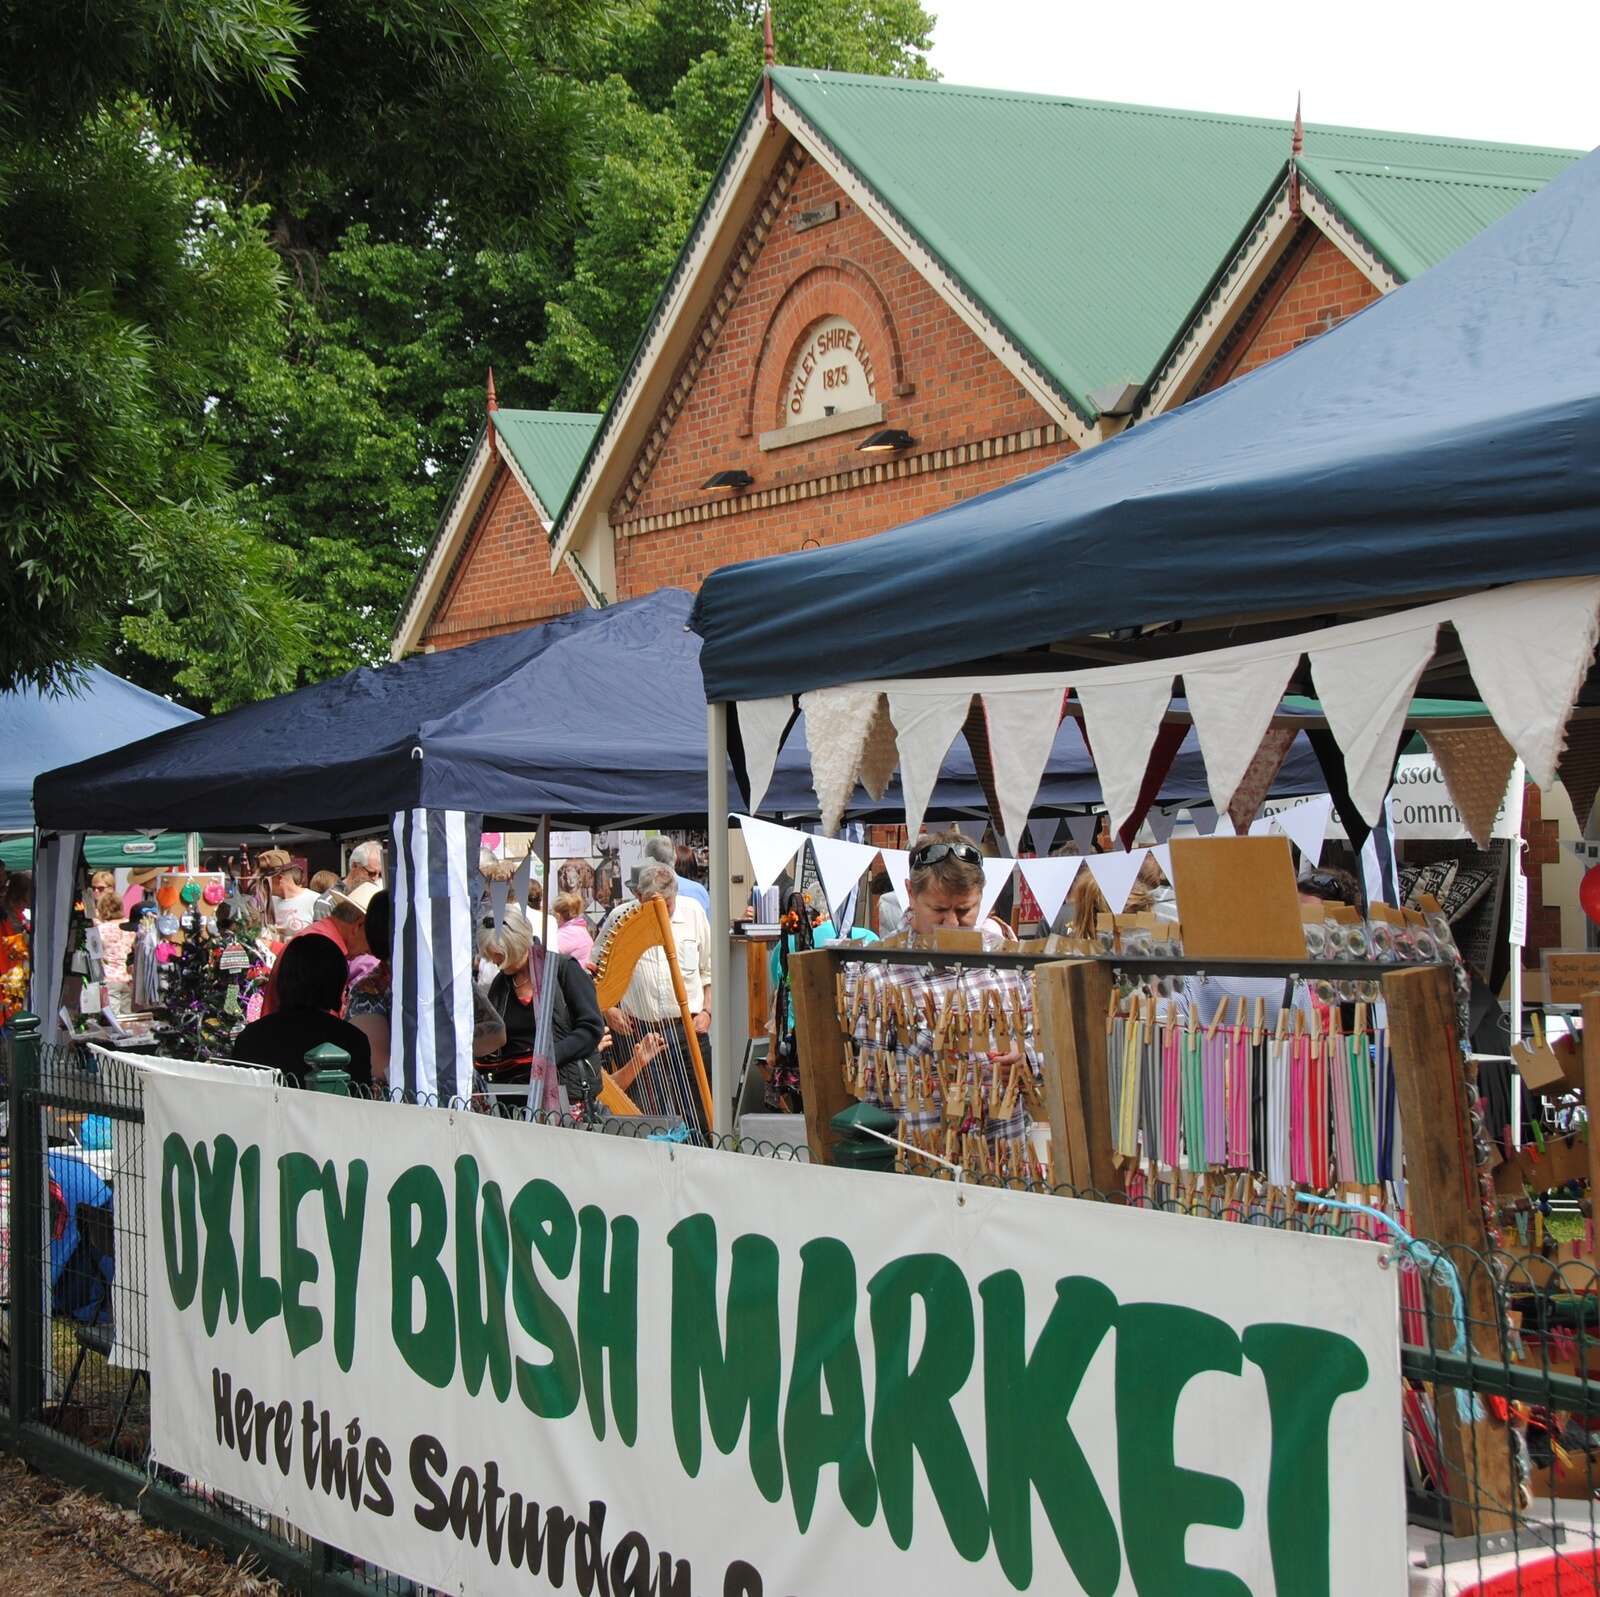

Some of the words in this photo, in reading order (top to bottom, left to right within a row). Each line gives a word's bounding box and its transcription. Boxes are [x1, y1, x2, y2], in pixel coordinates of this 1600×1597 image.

[790, 344, 818, 414] OXLEY
[817, 328, 857, 355] SHIRE
[854, 336, 876, 396] HALL
[822, 365, 849, 390] 1875
[161, 1132, 369, 1373] OXLEY
[386, 1153, 640, 1448] BUSH
[667, 1211, 1369, 1597] MARKET
[212, 1366, 294, 1477] Here
[302, 1400, 395, 1516] this
